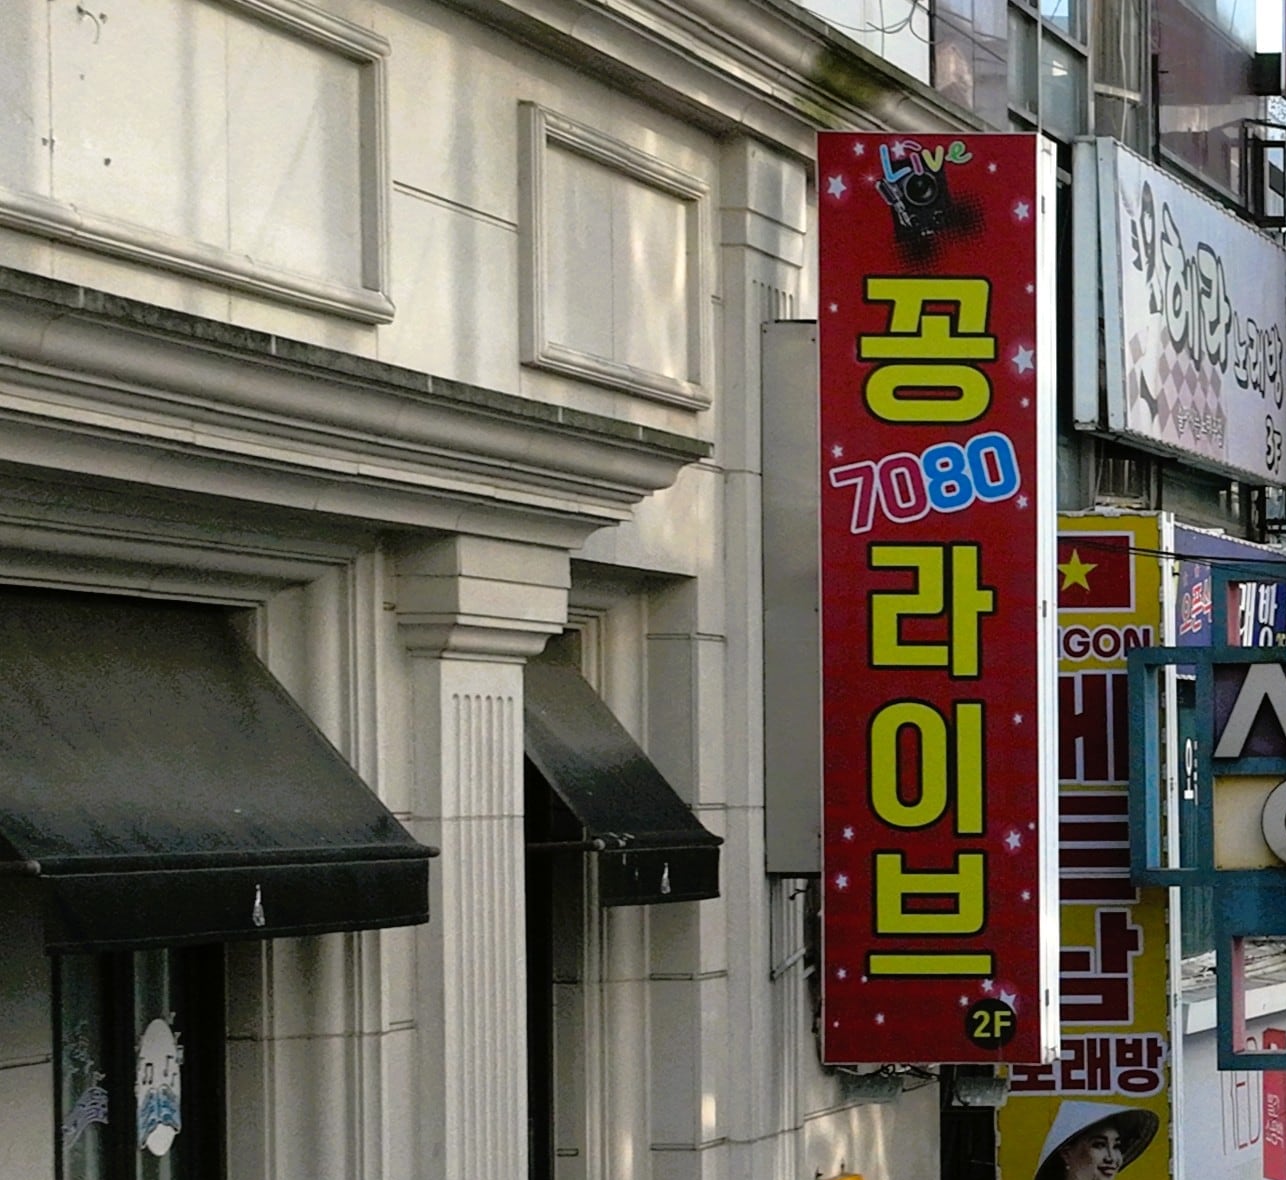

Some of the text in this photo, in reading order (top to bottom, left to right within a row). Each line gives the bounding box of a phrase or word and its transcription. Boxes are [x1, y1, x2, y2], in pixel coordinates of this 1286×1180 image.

[879, 140, 972, 186] Live
[857, 275, 998, 425] 꽁
[829, 431, 1021, 535] 7080
[1058, 625, 1153, 659] GON
[867, 541, 996, 979] 라이브
[973, 1010, 1013, 1040] 2F
